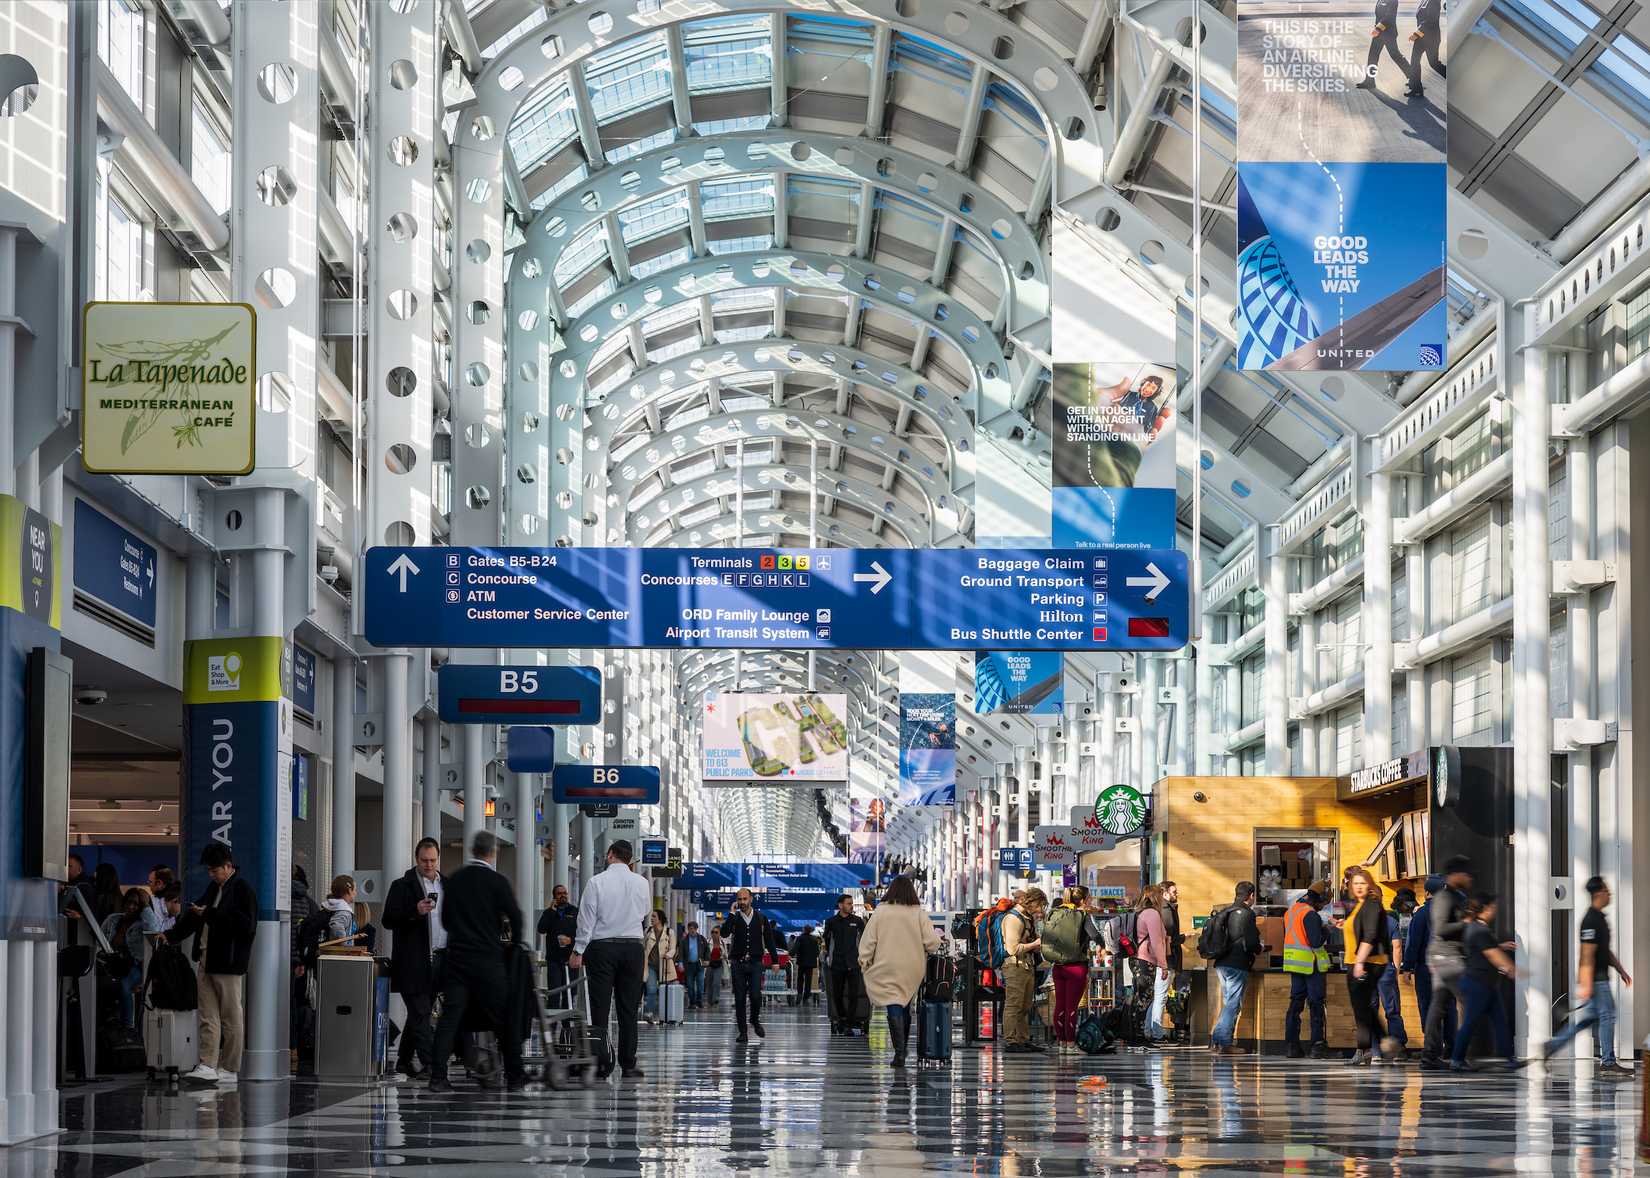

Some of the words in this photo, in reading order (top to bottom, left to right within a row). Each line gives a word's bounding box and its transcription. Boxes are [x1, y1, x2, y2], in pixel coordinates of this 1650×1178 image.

[1263, 20, 1299, 34] THIS
[1304, 20, 1319, 34] IS
[1323, 20, 1354, 34] THE
[1263, 35, 1314, 48] STORY
[1320, 35, 1342, 48] OF
[1263, 50, 1287, 63] AN
[1291, 50, 1354, 63] AIRLINE
[1264, 64, 1378, 78] DIVERSIFYING
[1262, 79, 1294, 92] THE
[1297, 79, 1350, 92] SKIES.
[1314, 236, 1368, 250] GOOD
[1314, 251, 1369, 264] LEADS
[1325, 265, 1357, 279] THE
[1321, 280, 1360, 294] WAY
[1317, 349, 1375, 358] UNITED
[89, 359, 124, 384] La
[129, 359, 247, 392] Tapenade
[100, 399, 234, 410] MEDITERRANEAN
[1067, 406, 1087, 415] GET
[1088, 406, 1098, 415] IN
[1100, 406, 1136, 415] TOUCH
[193, 411, 235, 428] CAFÉ
[1067, 415, 1093, 424] WITH
[1094, 415, 1110, 424] AN
[1111, 415, 1145, 424] AGENT
[1067, 424, 1114, 433] WITHOUT
[1067, 432, 1119, 442] STANDING
[1120, 432, 1131, 442] IN
[29, 524, 46, 552] NEAR
[32, 548, 44, 574] YOU
[449, 555, 458, 566] B
[467, 555, 505, 568] Gates
[509, 555, 557, 567] B5-B24
[691, 557, 753, 568] Terminals
[764, 557, 772, 568] 2
[781, 557, 790, 568] 3
[798, 557, 807, 568] 5
[978, 558, 1040, 572] Baggage
[1044, 558, 1084, 570] Claim
[449, 573, 458, 584] C
[467, 573, 538, 585] Concourse
[640, 574, 718, 586] Concourses
[723, 575, 732, 585] E
[739, 575, 747, 585] F
[752, 575, 763, 585] G
[768, 575, 778, 585] H
[783, 575, 794, 585] K
[799, 575, 807, 585] L
[960, 576, 1013, 588] Ground
[1016, 576, 1084, 590] Transport
[467, 591, 496, 602] ATM
[1030, 593, 1084, 608] Parking
[1096, 594, 1105, 604] P
[467, 608, 529, 620] Customer
[534, 608, 582, 620] Service
[586, 608, 630, 620] Center
[682, 608, 712, 620] ORD
[716, 608, 758, 622] Family
[762, 608, 810, 623] Lounge
[1039, 610, 1084, 622] Hilton
[666, 627, 710, 640] Airport
[714, 627, 758, 639] Transit
[762, 627, 810, 641] System
[951, 629, 977, 640] Bus
[981, 628, 1032, 640] Shuttle
[1036, 628, 1084, 640] Center
[500, 670, 540, 695] B5
[212, 718, 234, 791] YOU
[706, 748, 742, 758] WELCOME
[706, 758, 714, 767] TO
[593, 768, 620, 784] B6
[706, 768, 730, 776] PUBLIC
[730, 768, 754, 776] PARKS
[1350, 765, 1381, 793] STARBUCKS
[1382, 758, 1402, 785] COFFEE
[212, 800, 233, 852] AR
[1082, 836, 1104, 845] KING
[1100, 888, 1124, 896] SNACKS
